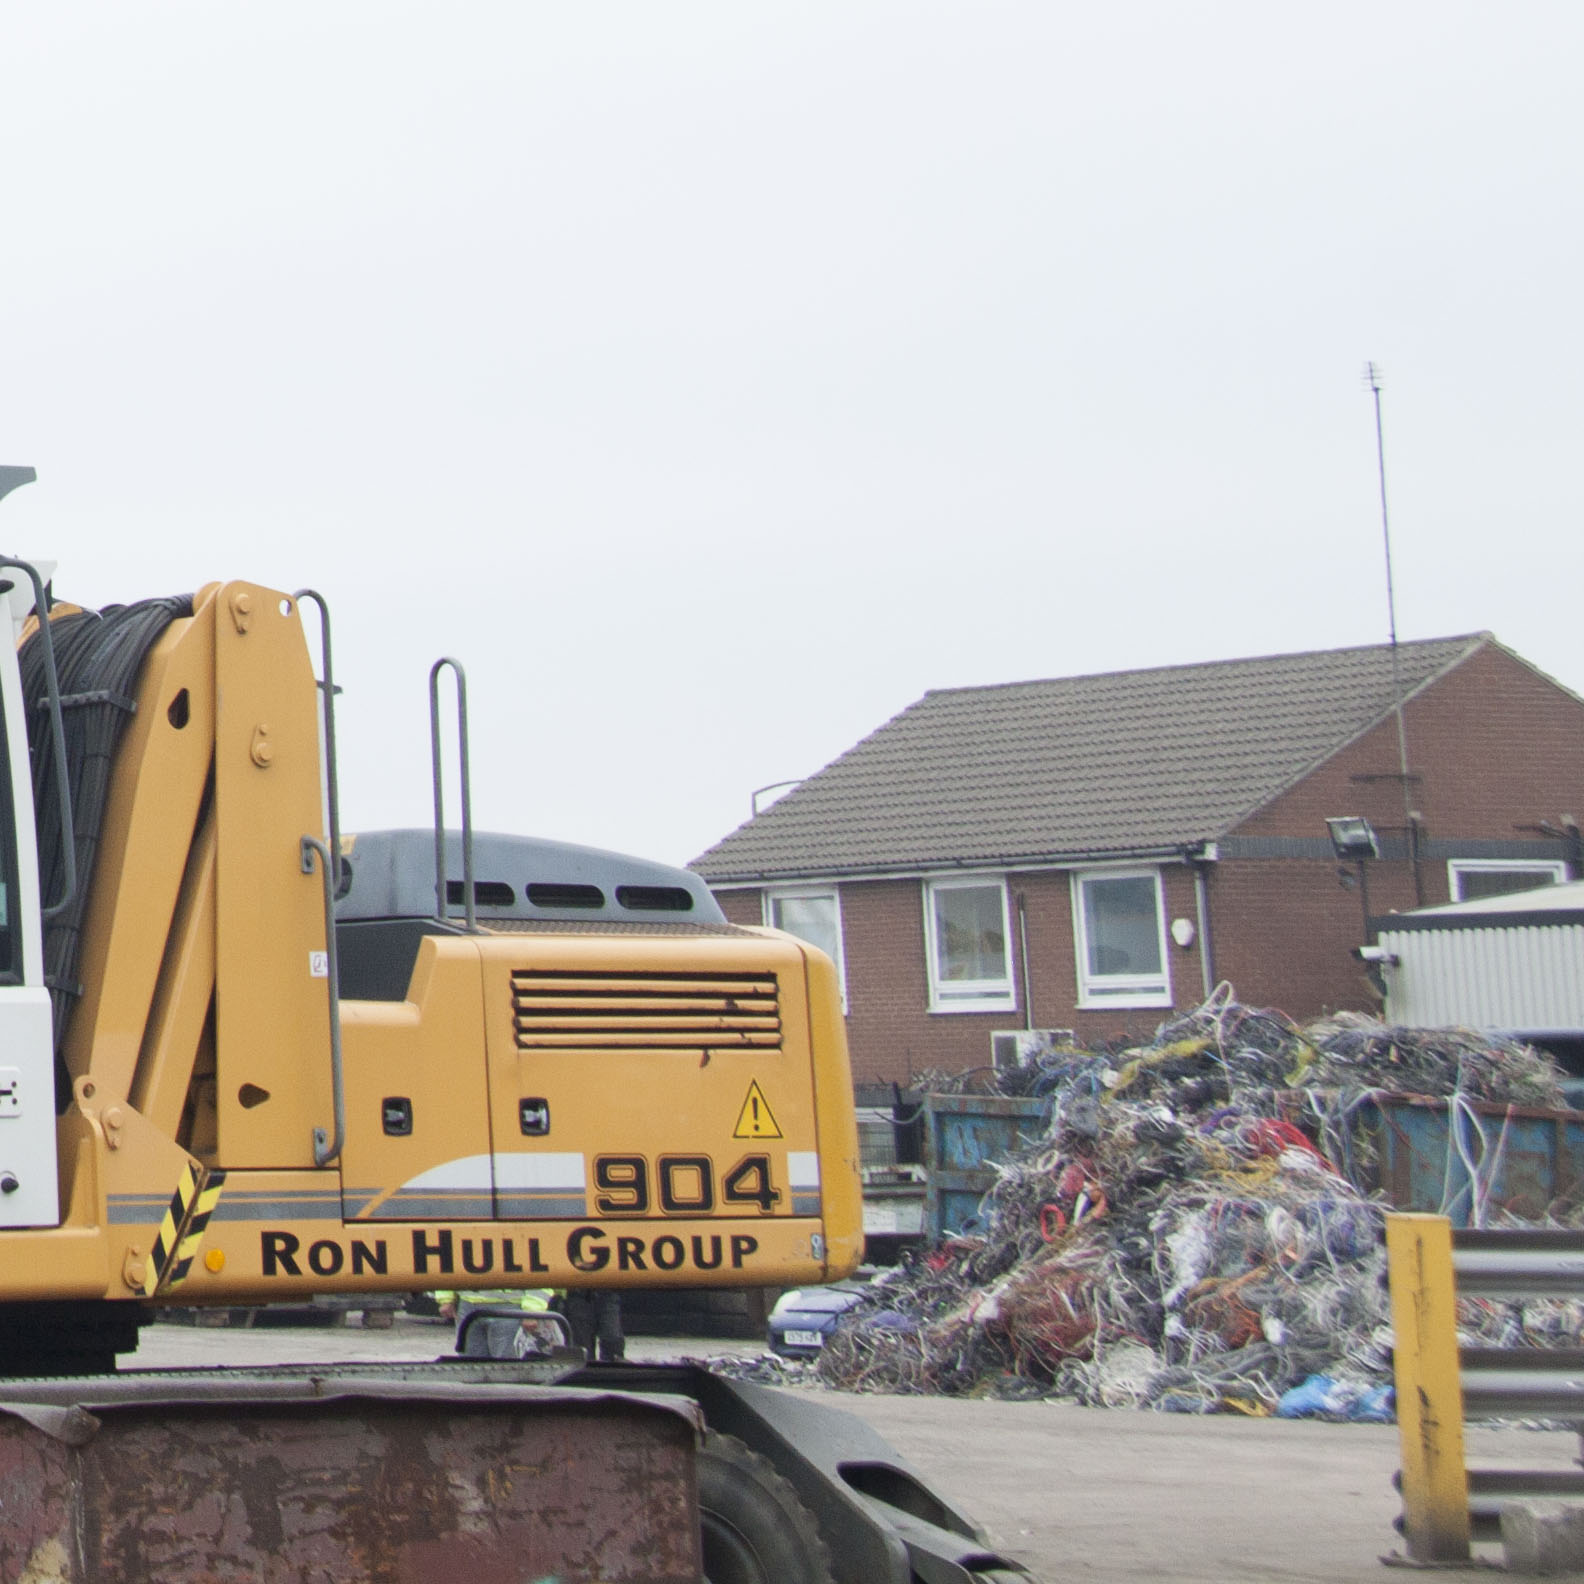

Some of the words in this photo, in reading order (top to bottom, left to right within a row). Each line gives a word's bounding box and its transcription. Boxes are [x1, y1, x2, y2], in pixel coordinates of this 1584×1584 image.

[593, 1153, 783, 1216] 904
[261, 1230, 388, 1277] RON
[412, 1229, 549, 1275] HULL
[566, 1227, 759, 1272] GROUP
